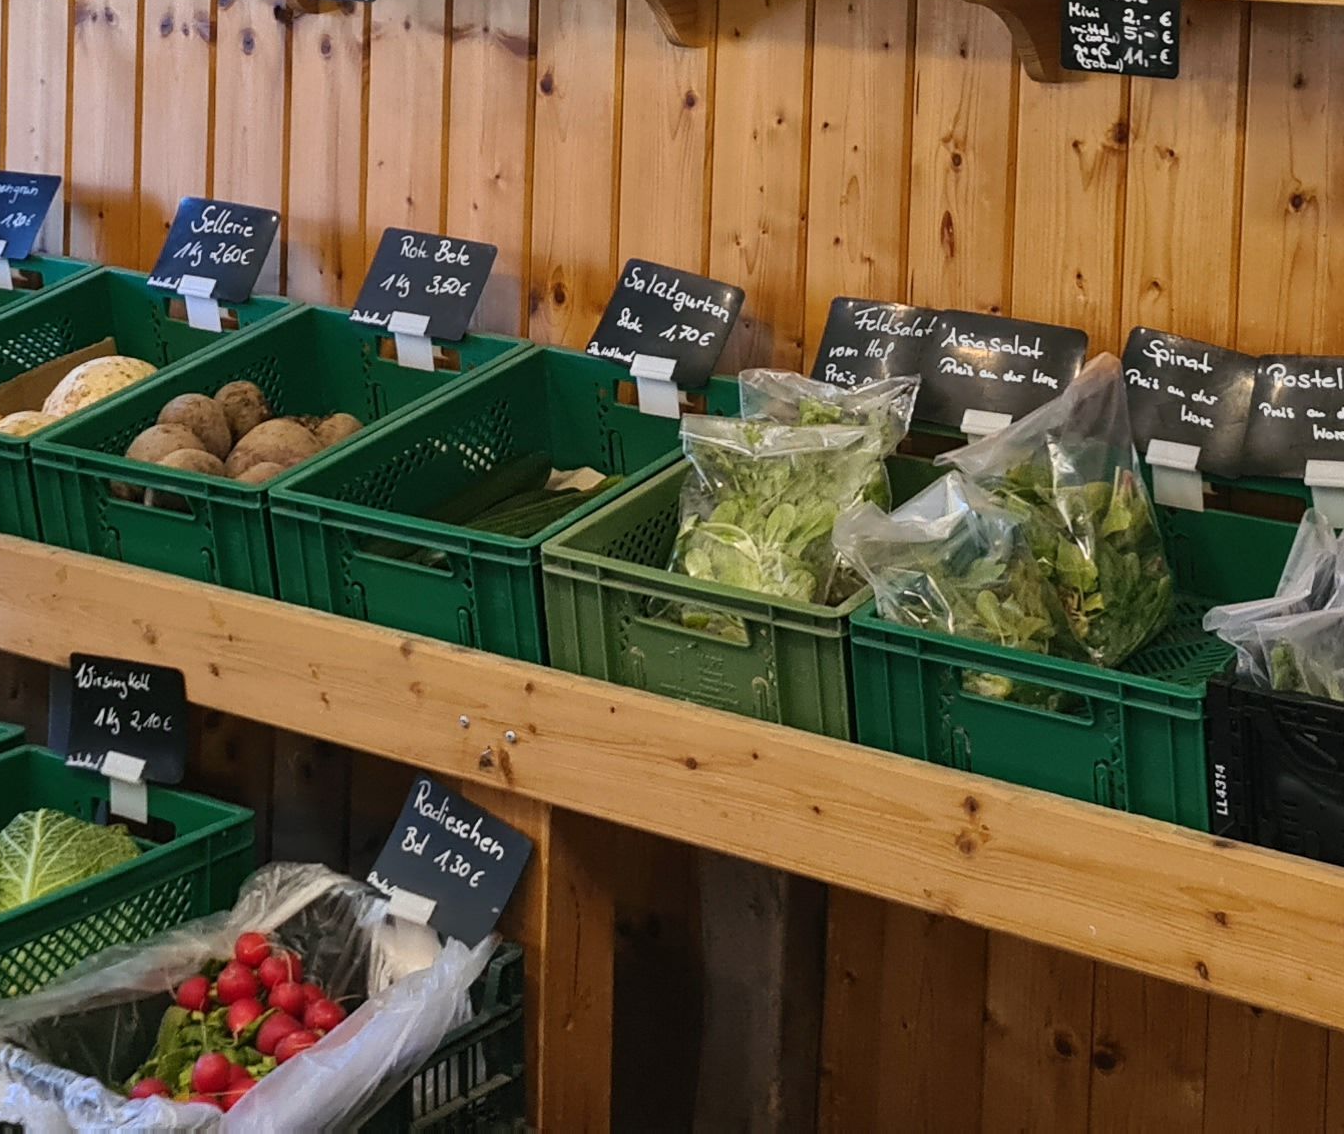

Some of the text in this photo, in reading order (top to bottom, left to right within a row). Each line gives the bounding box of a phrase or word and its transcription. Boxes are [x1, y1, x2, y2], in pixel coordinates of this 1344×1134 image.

[1159, 11, 1172, 27] €
[1162, 31, 1174, 45] €
[1159, 48, 1173, 65] €
[191, 205, 254, 237] Sellerie
[400, 235, 471, 266] Rote Bete
[624, 267, 730, 324] Salatgurken
[855, 306, 939, 337] Feldsalat
[828, 339, 895, 367] vom Hof
[1142, 339, 1213, 373] Spinat
[824, 364, 857, 386] Preis
[939, 357, 1059, 390] Preis an der Ware
[1125, 368, 1219, 405] Preis an der
[1180, 404, 1214, 429] Ware
[1258, 402, 1295, 419] Preis
[1307, 408, 1326, 418] an
[413, 779, 505, 861] Radieschen
[401, 826, 431, 857] Bd
